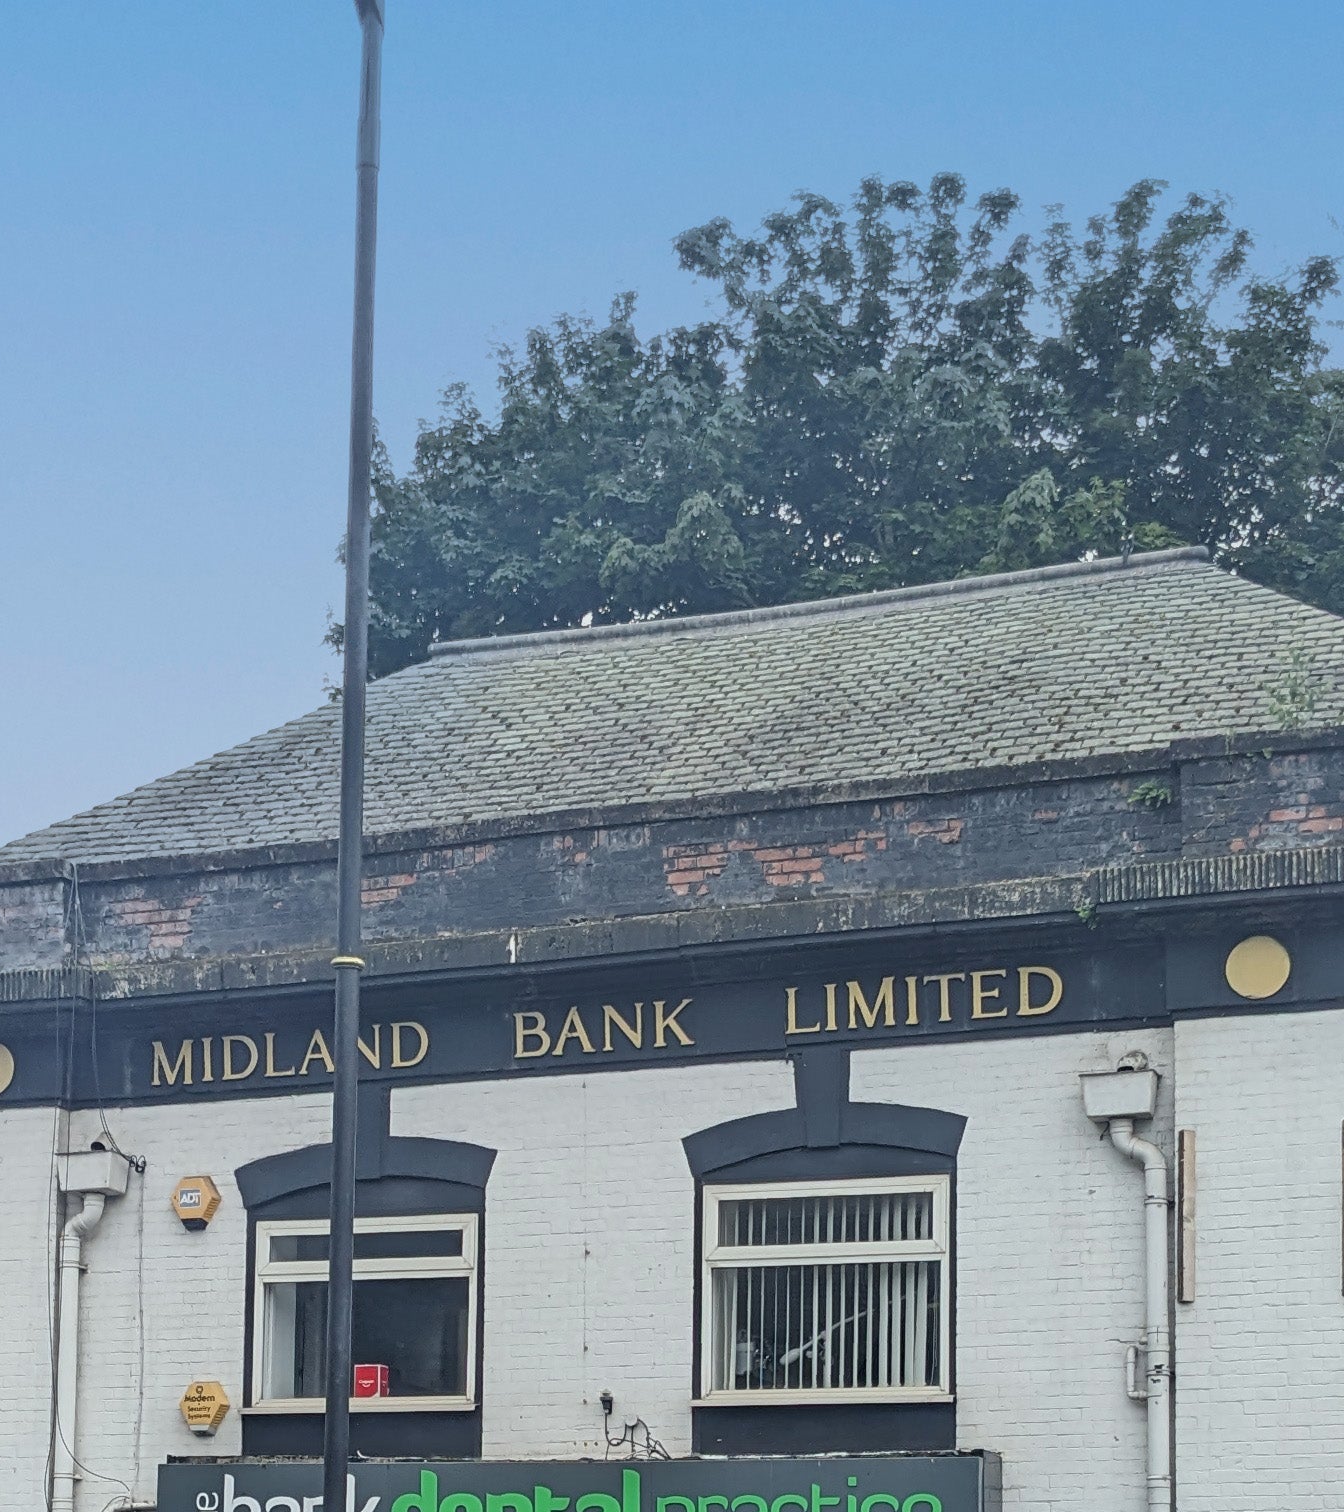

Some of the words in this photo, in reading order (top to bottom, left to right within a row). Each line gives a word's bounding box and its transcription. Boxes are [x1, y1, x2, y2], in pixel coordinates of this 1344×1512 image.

[514, 997, 695, 1061] BANK
[784, 964, 1064, 1036] LIMITED
[180, 1192, 201, 1204] ADT
